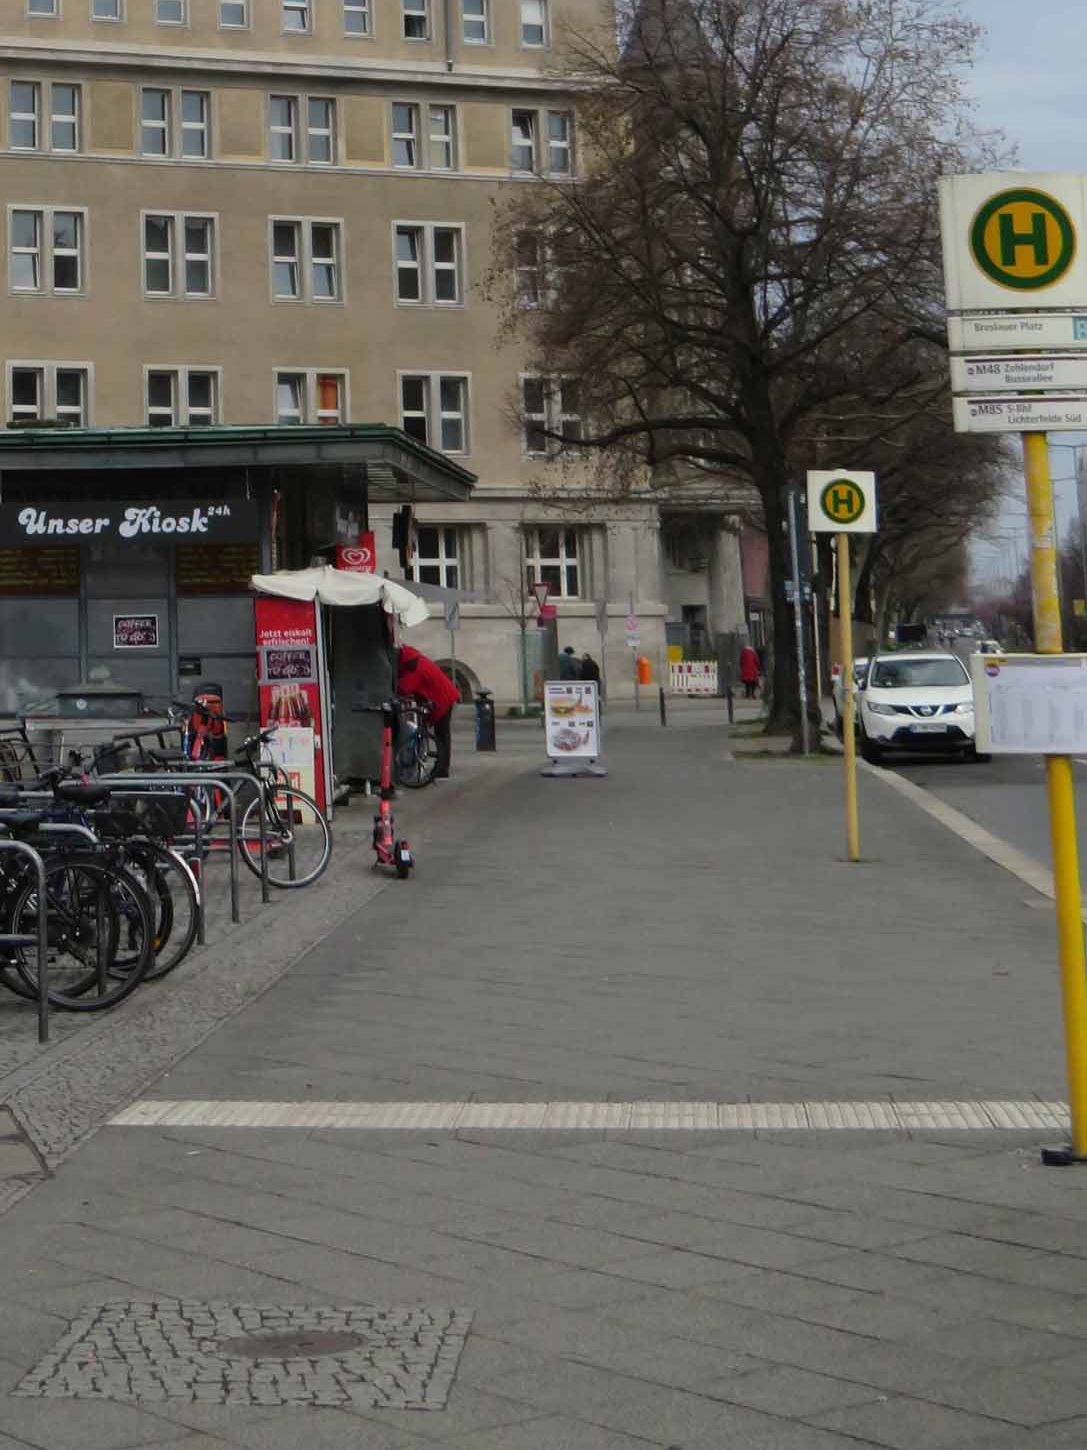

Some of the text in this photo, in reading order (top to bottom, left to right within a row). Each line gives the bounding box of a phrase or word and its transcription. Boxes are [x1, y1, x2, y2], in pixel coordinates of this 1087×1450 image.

[998, 212, 1049, 267] H
[974, 320, 1043, 332] Breslauer Platz
[976, 362, 1054, 375] M48 Zehlendorf
[978, 405, 1003, 415] M85
[1065, 412, 1081, 423] Süd
[831, 489, 854, 515] H
[17, 505, 231, 538] Unser Kiosk 24h
[260, 628, 312, 638] Jetzt eiskalt
